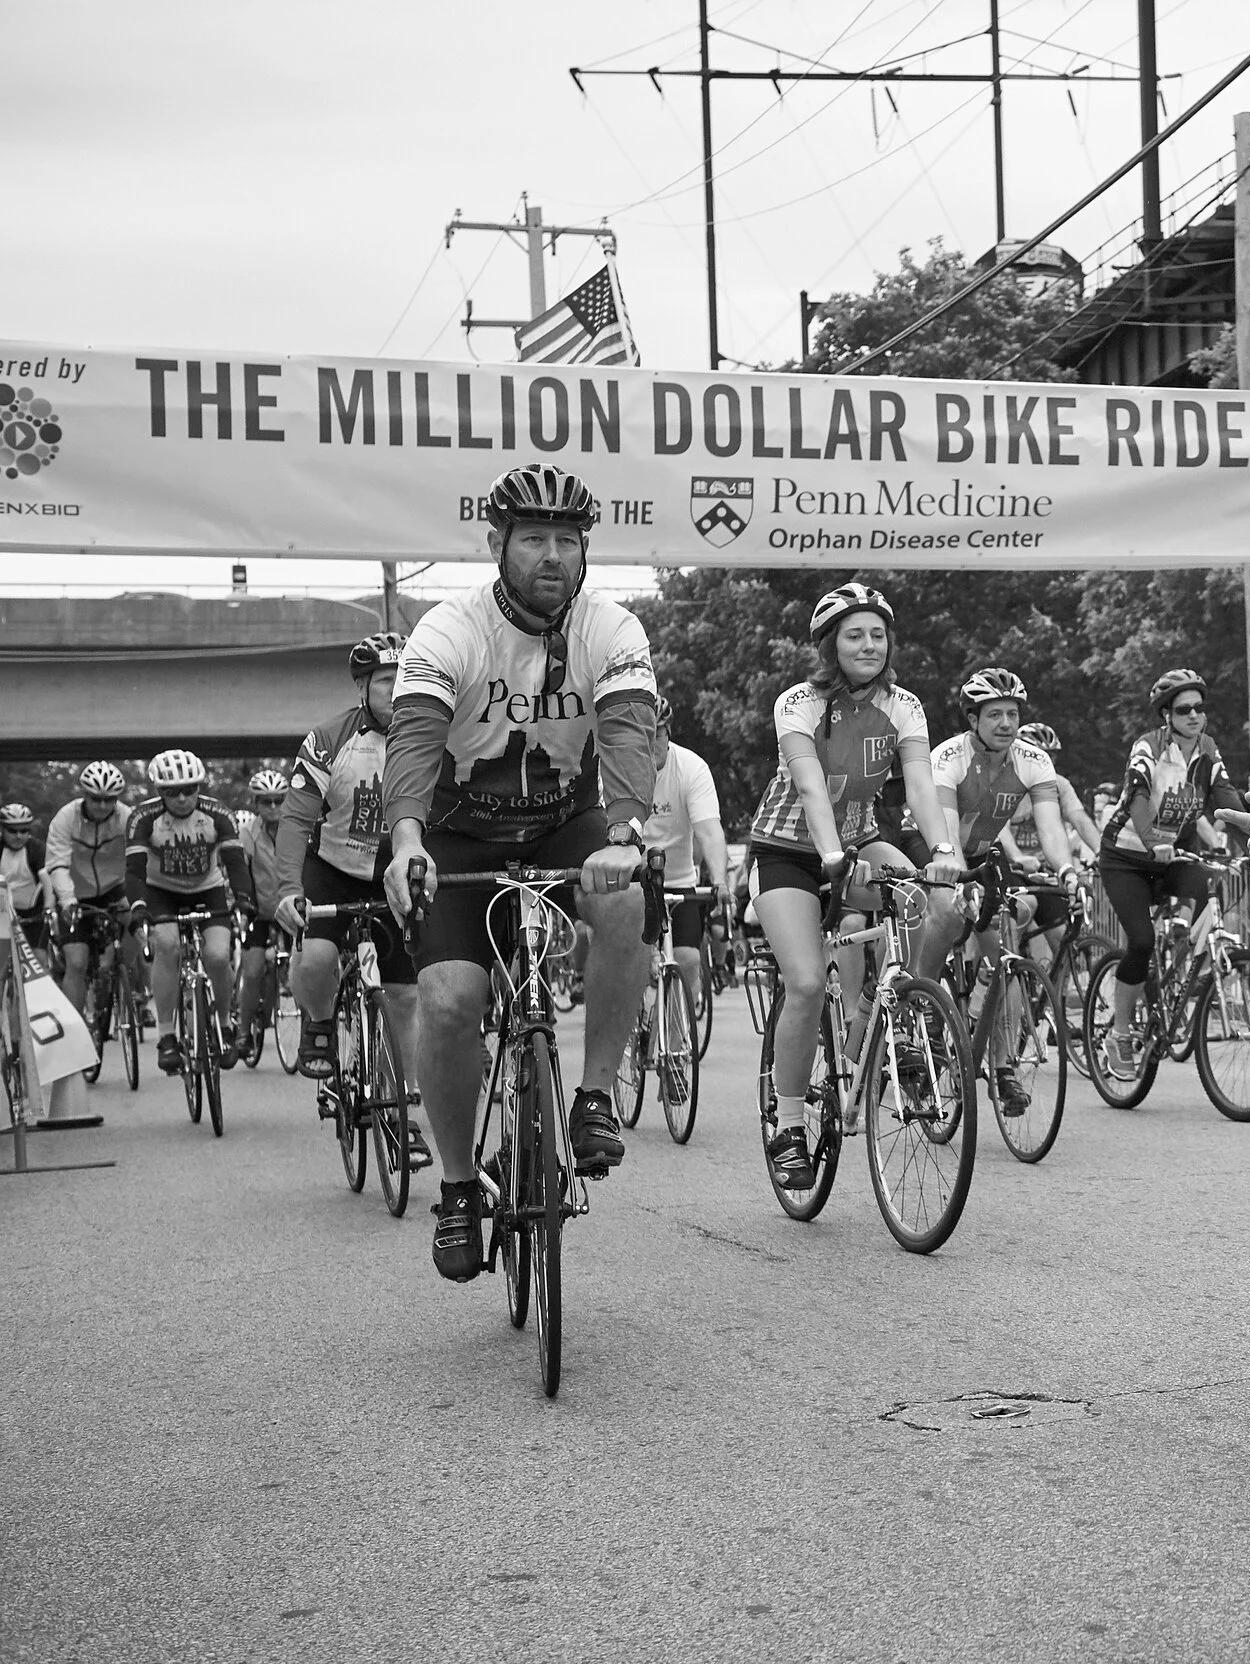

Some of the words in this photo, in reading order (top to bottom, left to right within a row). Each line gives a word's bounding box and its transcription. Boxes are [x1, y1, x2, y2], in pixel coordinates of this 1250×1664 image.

[0, 357, 48, 378] ered
[58, 357, 86, 384] by
[135, 357, 285, 442] THE
[317, 367, 621, 454] MILLION
[653, 381, 908, 462] DOLLAR
[936, 392, 1081, 467] BIKE
[1107, 398, 1250, 469] RIDE
[770, 477, 866, 515] Penn
[875, 478, 1053, 518] Medicine
[611, 500, 653, 525] THE
[768, 528, 862, 552] Orphan
[869, 530, 961, 550] Disease
[966, 530, 1044, 548] Center
[477, 678, 587, 724] Penn
[510, 796, 529, 808] to
[356, 819, 390, 834] RID
